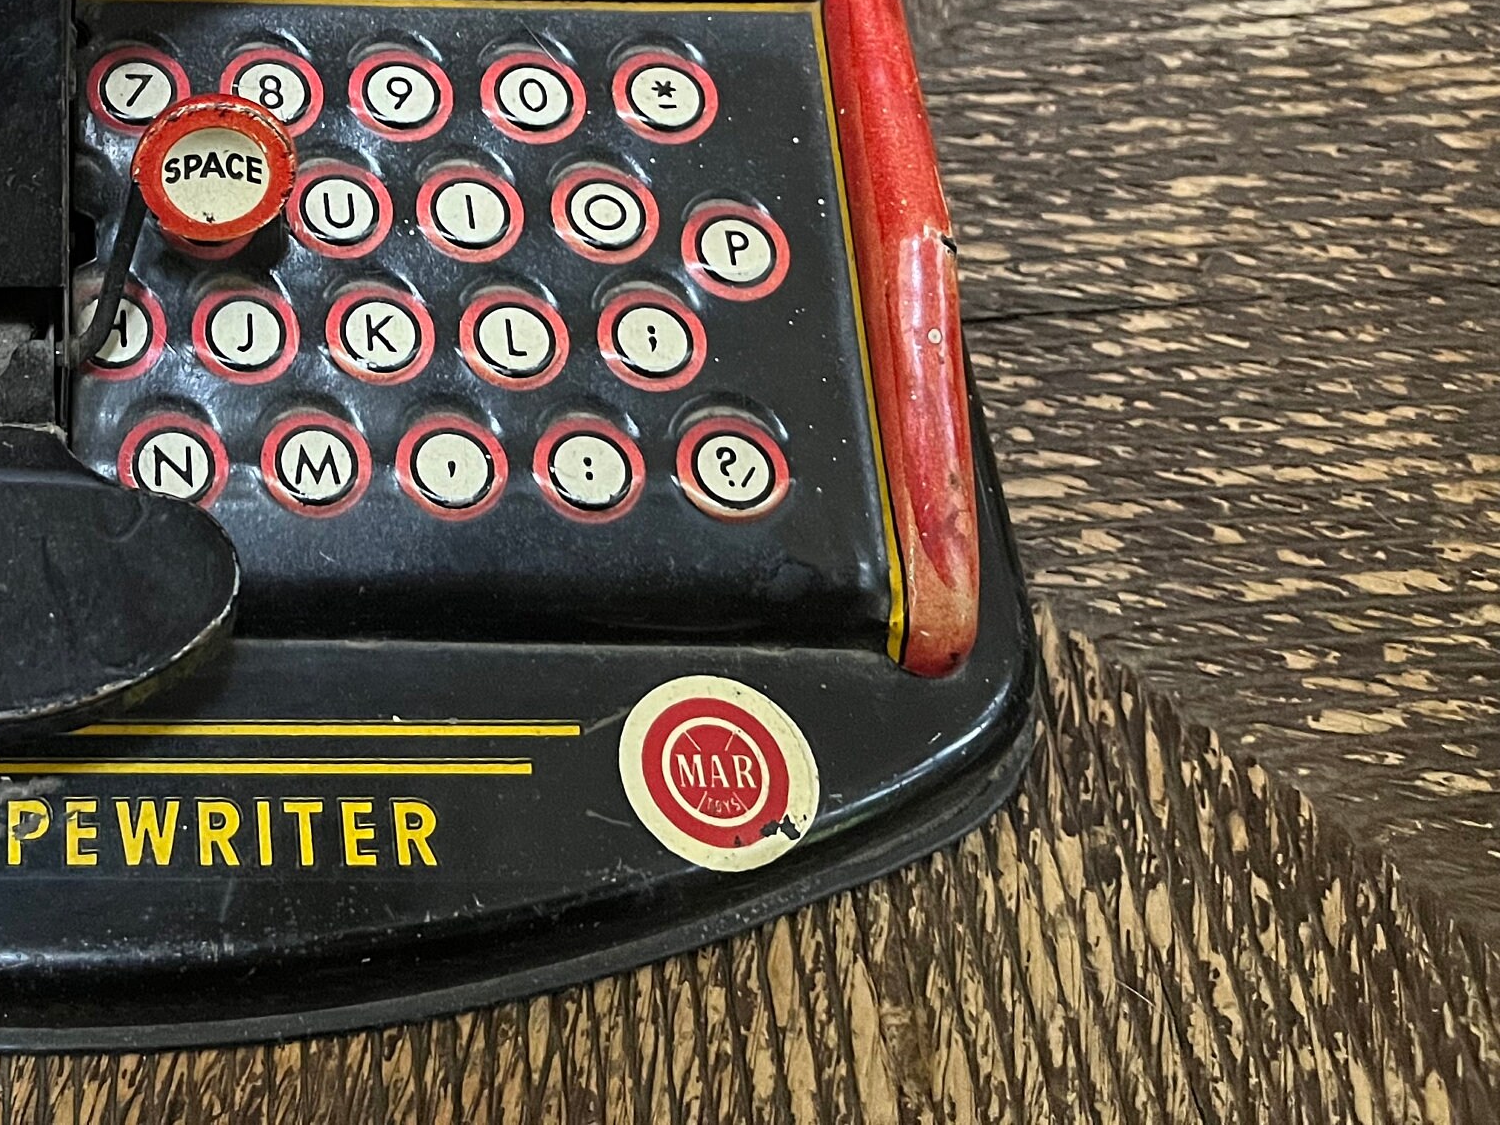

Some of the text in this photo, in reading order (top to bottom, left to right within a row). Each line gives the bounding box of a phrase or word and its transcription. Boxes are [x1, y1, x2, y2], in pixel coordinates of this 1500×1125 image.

[125, 74, 153, 107] 7
[260, 75, 283, 109] 8
[387, 77, 412, 109] 9
[163, 152, 264, 186] SPACE
[324, 193, 354, 228] U
[466, 195, 475, 229] I
[585, 195, 626, 230] O
[725, 231, 749, 265] P
[237, 313, 253, 352] J
[366, 315, 397, 352] K
[506, 319, 527, 356] L
[154, 445, 193, 487] N
[296, 445, 340, 484] M
[675, 754, 757, 789] MAR
[707, 797, 743, 814] TOYS
